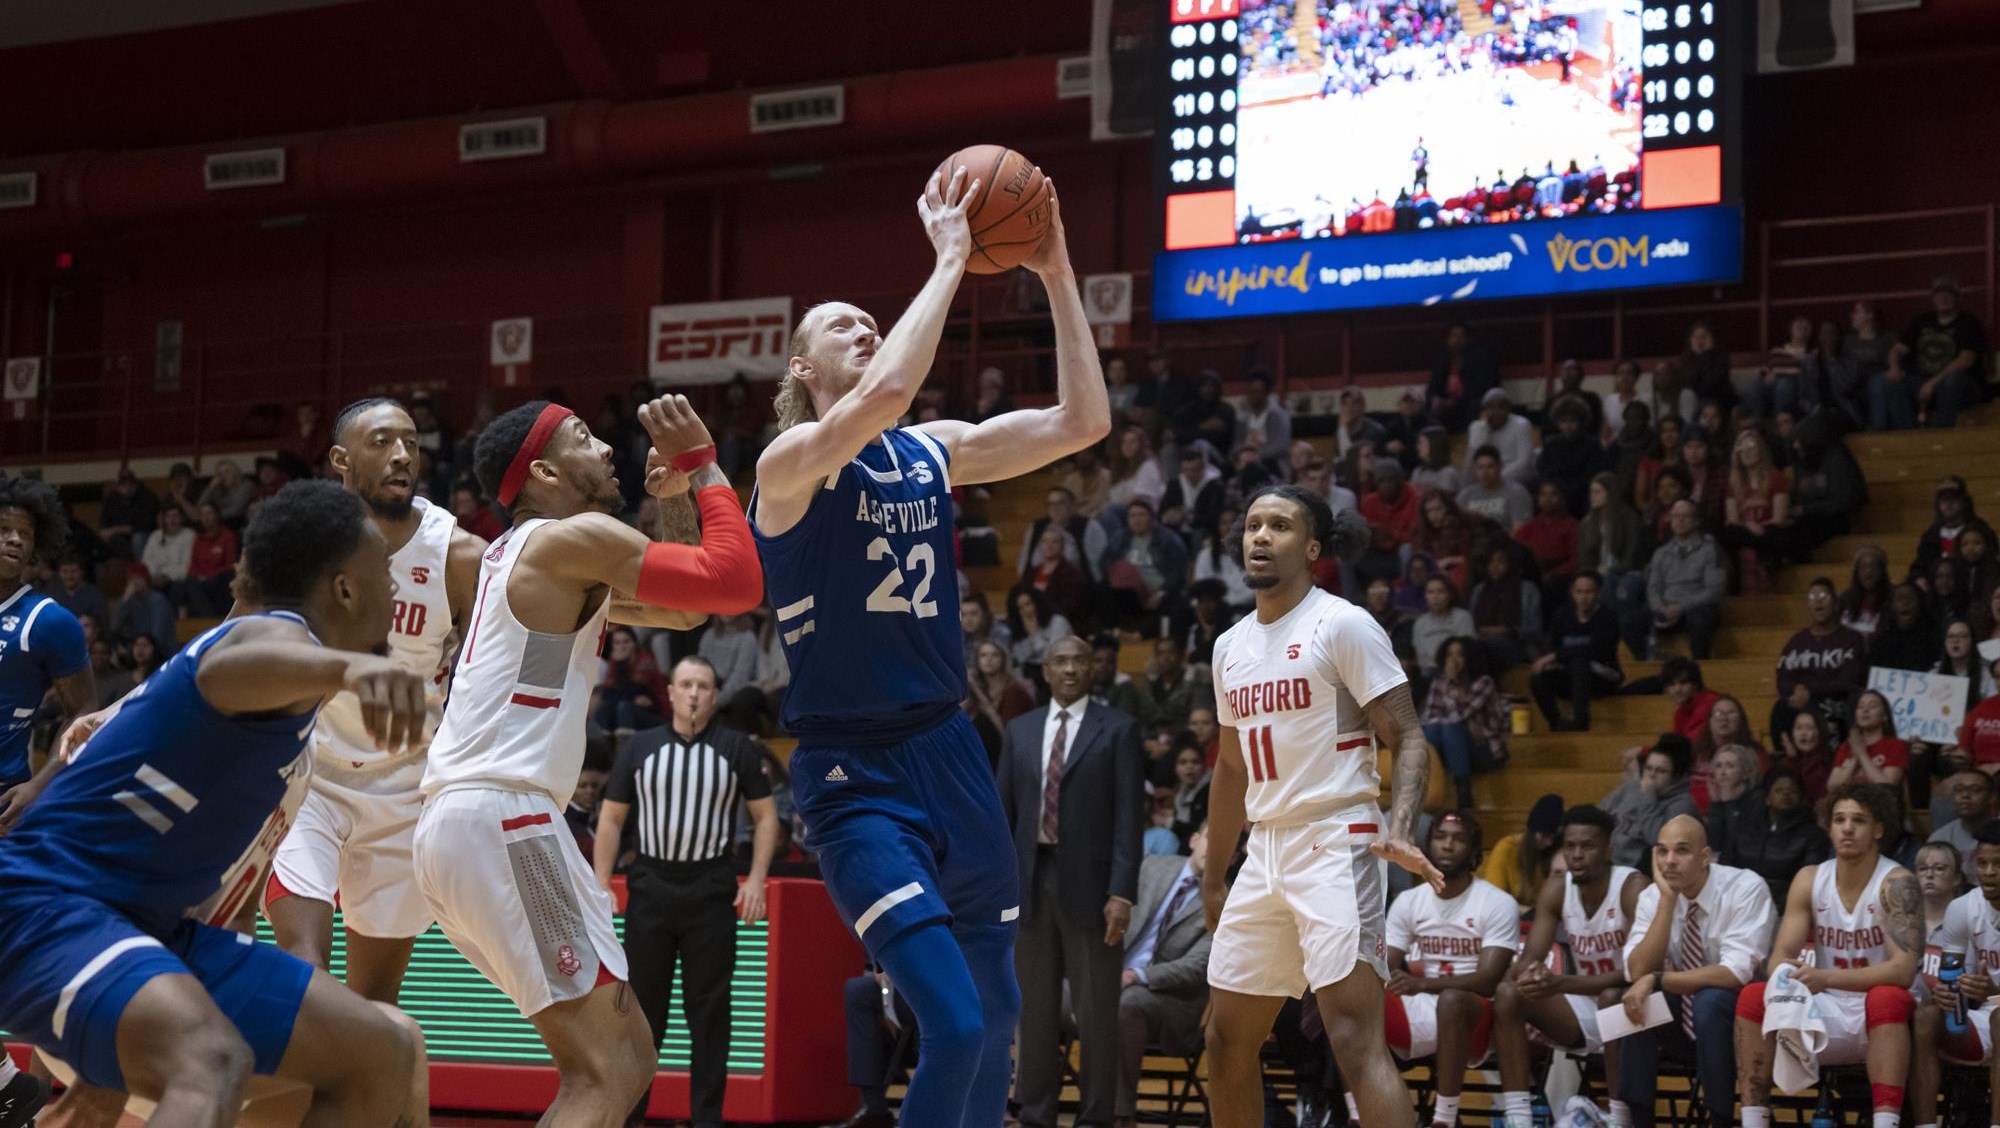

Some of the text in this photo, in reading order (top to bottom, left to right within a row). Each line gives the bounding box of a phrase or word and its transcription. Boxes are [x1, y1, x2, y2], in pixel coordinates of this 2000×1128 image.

[1700, 2, 1713, 25] 1
[1674, 41, 1691, 64] 0
[1698, 38, 1714, 61] 0
[1643, 75, 1714, 103] 11 0 0
[1172, 93, 1195, 117] 11
[1643, 109, 1714, 138] 22 0 0
[1197, 157, 1213, 181] 2
[1184, 251, 1513, 306] inspired to go to medical school?
[657, 313, 784, 362] ESPN
[866, 536, 938, 619] 22
[1225, 677, 1313, 721] ADFORD
[1893, 698, 1916, 716] GO
[1248, 724, 1280, 783] 11
[1817, 925, 1885, 951] RADFORD
